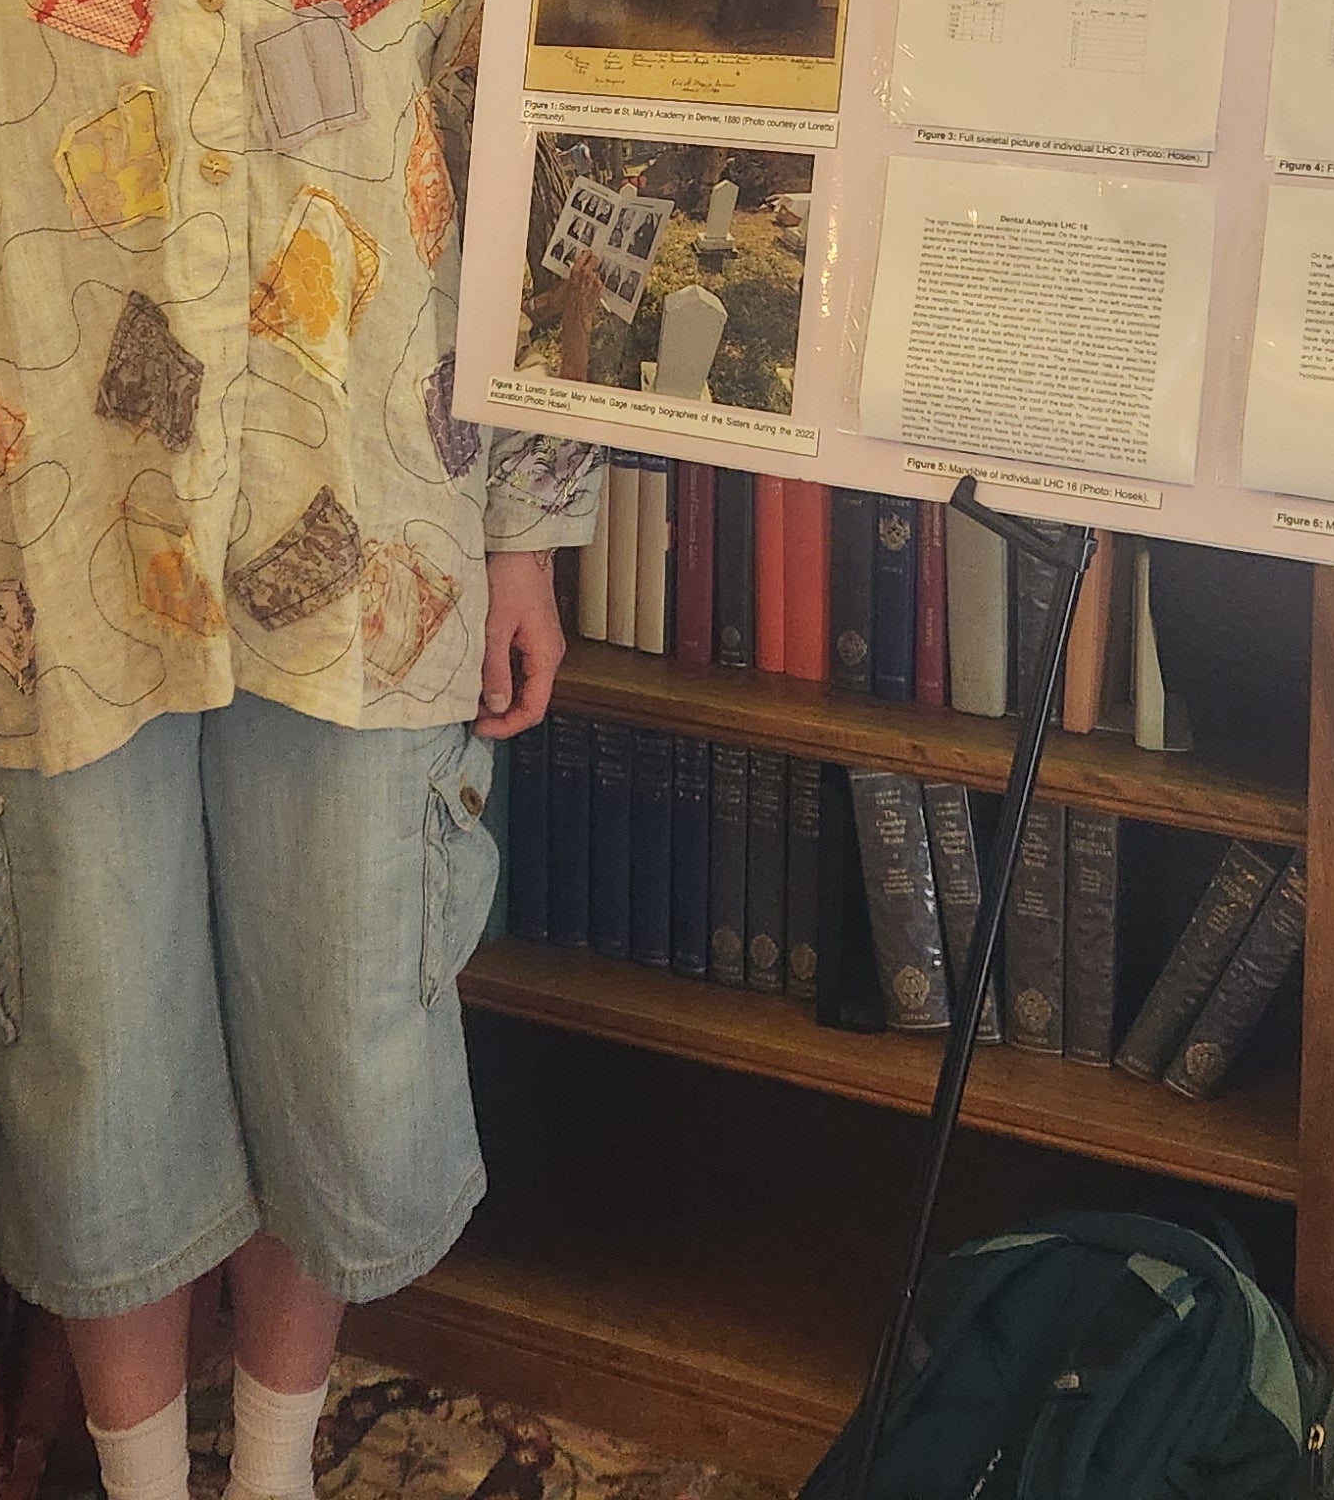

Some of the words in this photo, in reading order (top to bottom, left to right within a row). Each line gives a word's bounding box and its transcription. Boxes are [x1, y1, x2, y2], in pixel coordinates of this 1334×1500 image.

[1279, 160, 1312, 174] Figure
[1314, 162, 1324, 174] 4:
[1277, 512, 1311, 528] Figure
[1313, 517, 1323, 529] 6:
